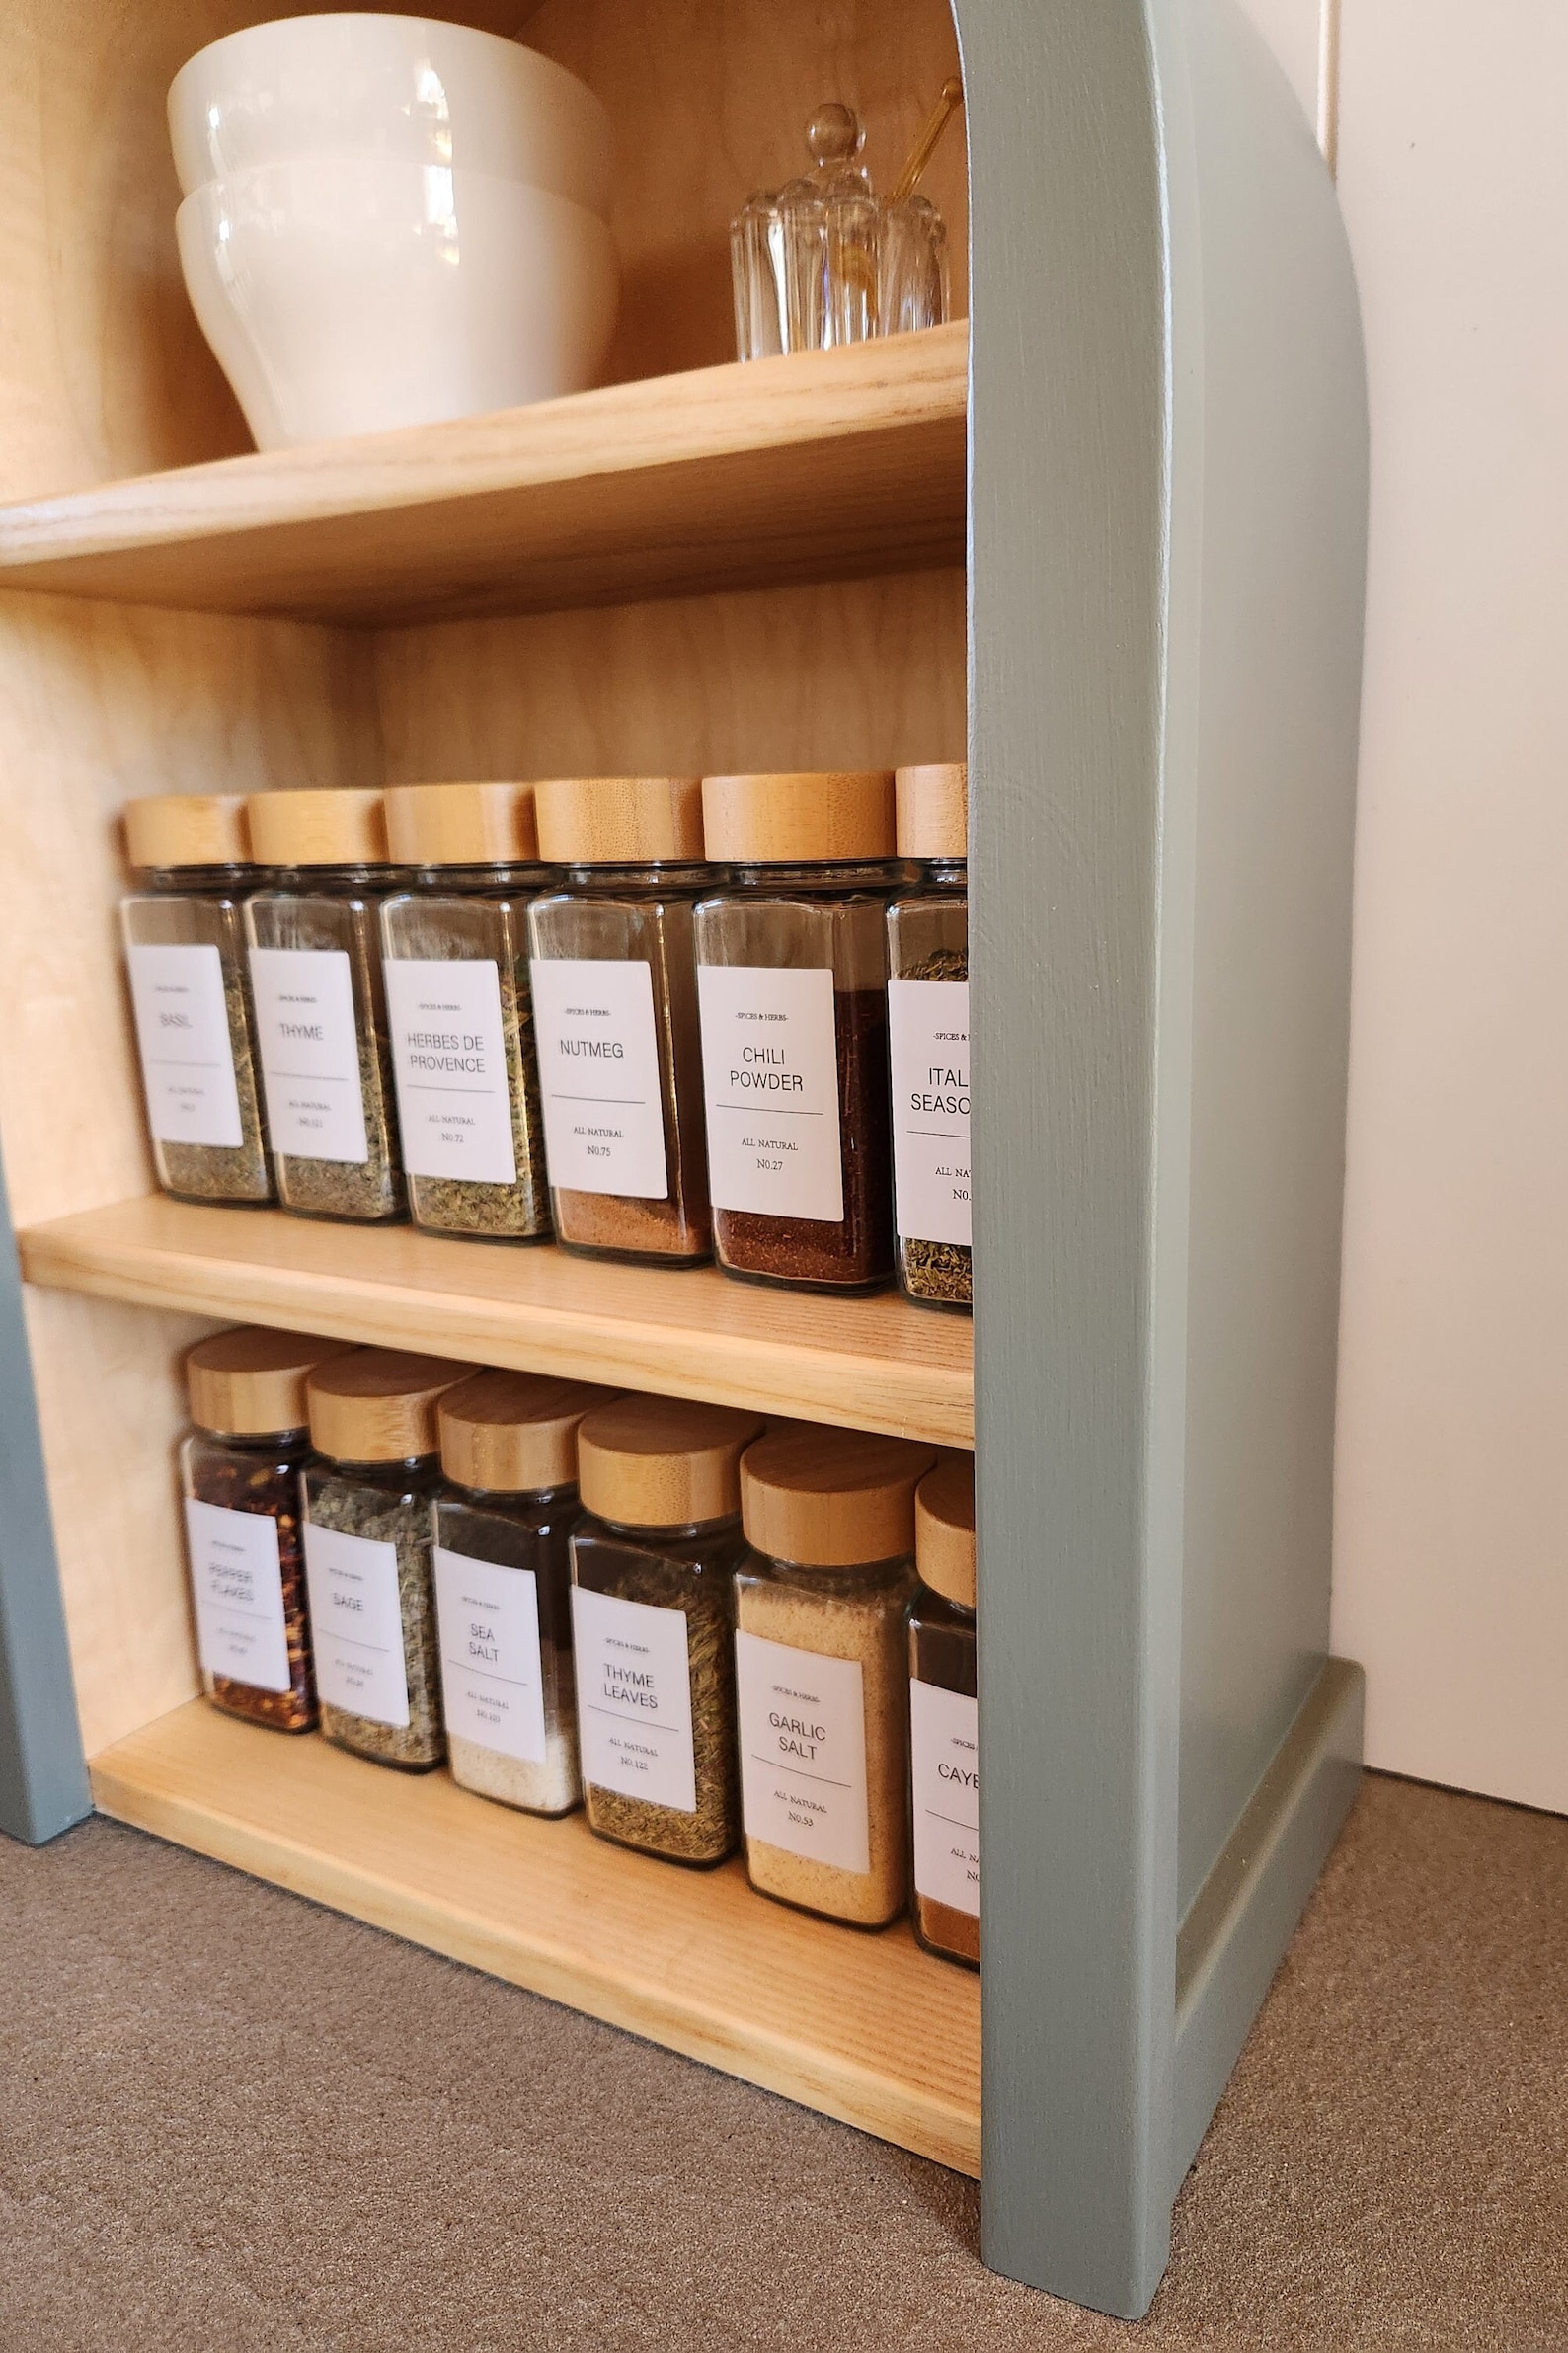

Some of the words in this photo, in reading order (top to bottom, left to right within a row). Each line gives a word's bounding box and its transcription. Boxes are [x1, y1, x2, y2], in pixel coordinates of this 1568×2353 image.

[279, 1023, 324, 1041] THYME
[407, 1033, 459, 1050] HERBES
[463, 1036, 484, 1051] DE
[560, 1039, 624, 1059] NUTMEG
[411, 1055, 486, 1073] PROVENCE
[743, 1047, 785, 1065] CHILI
[730, 1070, 804, 1092] POWDER
[929, 1067, 968, 1087] ITAL
[442, 1117, 476, 1126] NATURAL
[588, 1128, 624, 1137] NATURAL
[742, 1137, 755, 1146] ALL
[758, 1139, 798, 1151] NATURAL
[935, 1166, 952, 1176] ALL
[333, 1592, 363, 1611] SAGE
[470, 1624, 495, 1640] SEA
[469, 1642, 498, 1663] SALT
[604, 1663, 654, 1688] THYME
[603, 1684, 658, 1709] LEAVES
[769, 1712, 826, 1741] GARLIC
[609, 1737, 622, 1747] ALL
[624, 1741, 658, 1757] NATURAL
[778, 1736, 817, 1760] SALT
[774, 1790, 788, 1801] ALL
[790, 1796, 827, 1813] NATURAL
[950, 1847, 966, 1858] ALL
